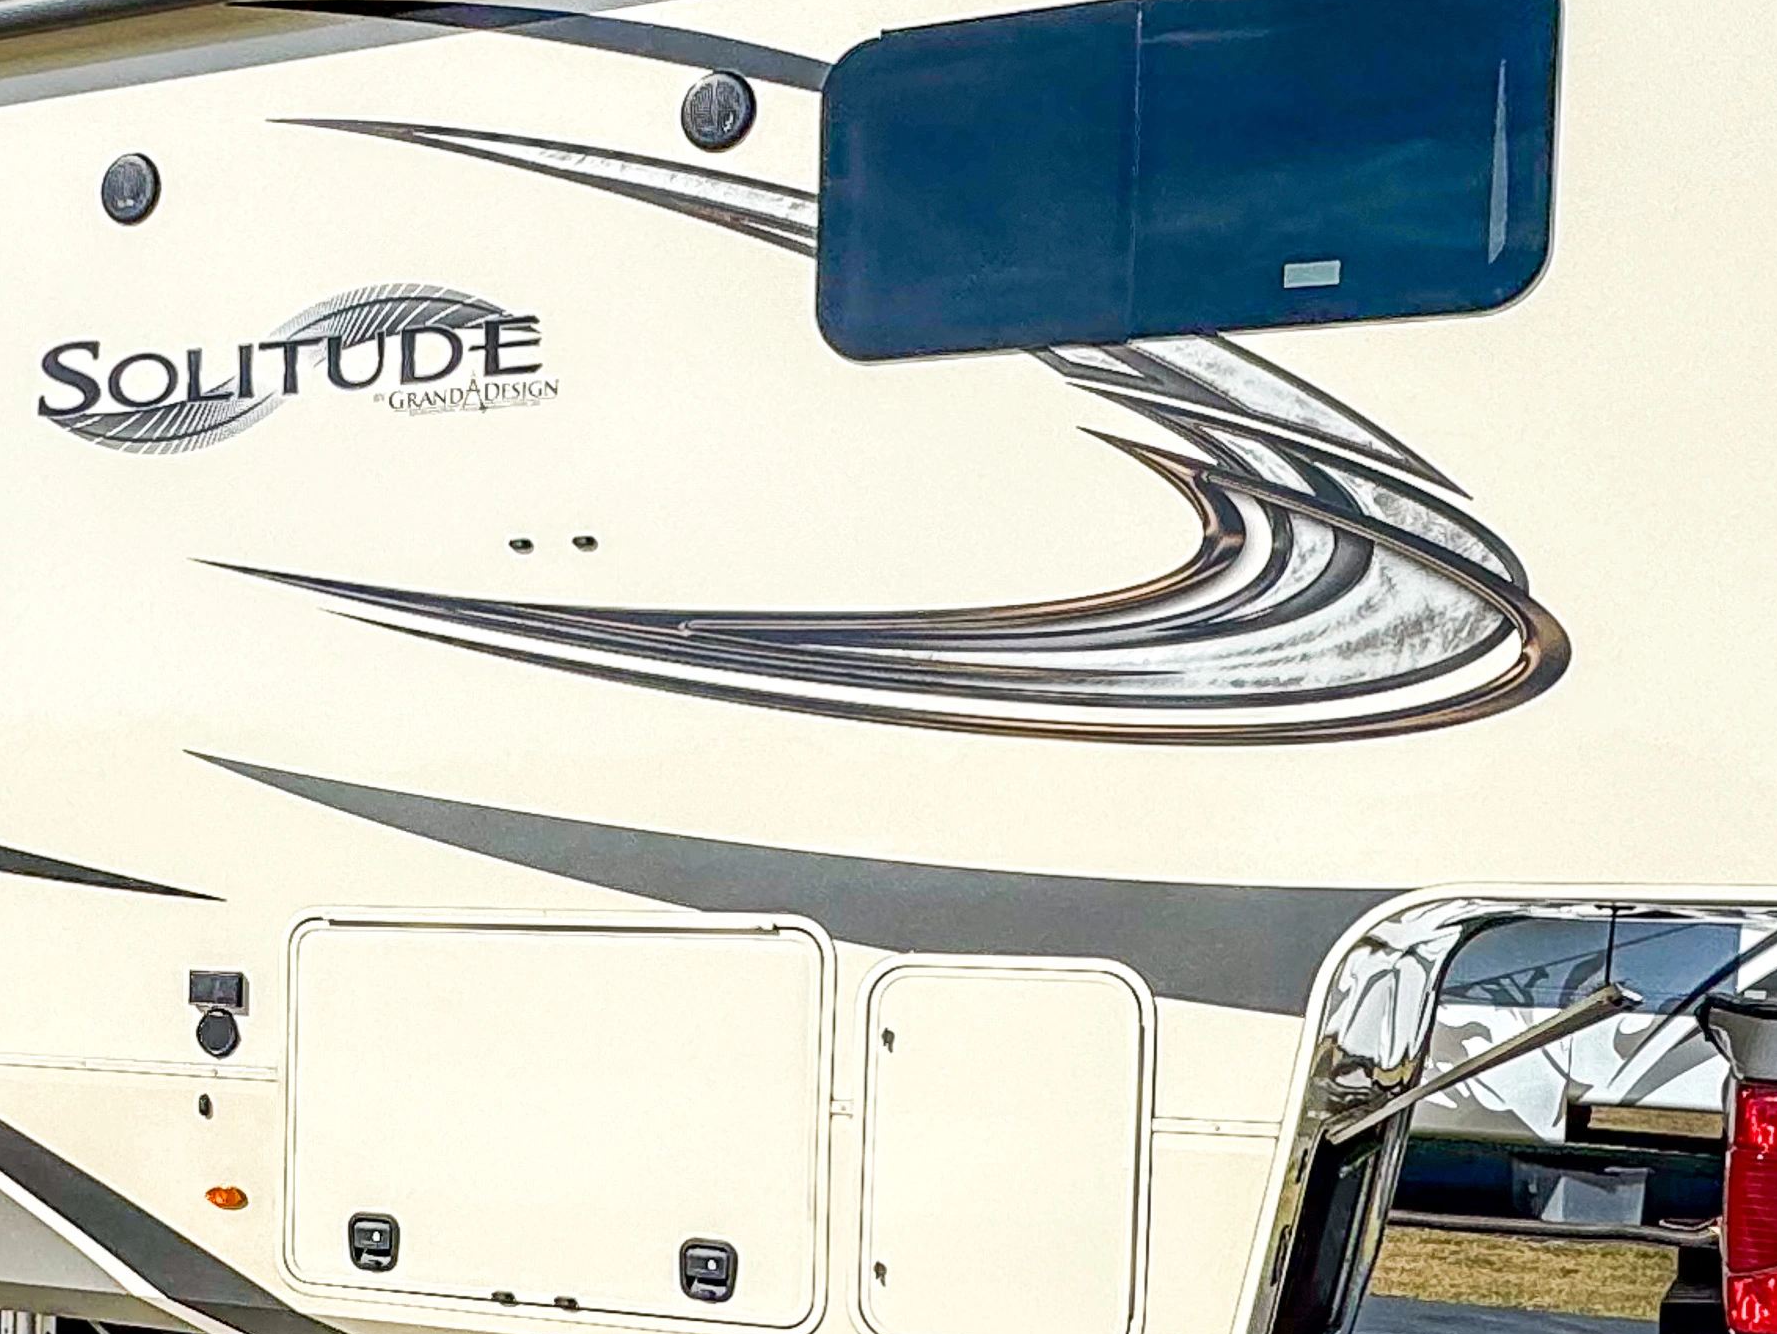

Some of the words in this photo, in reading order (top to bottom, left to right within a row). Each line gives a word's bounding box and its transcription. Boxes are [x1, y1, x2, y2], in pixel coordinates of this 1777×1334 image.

[37, 315, 543, 417] SOLITUDE
[388, 387, 465, 410] GRAND
[484, 378, 560, 403] DESIGN
